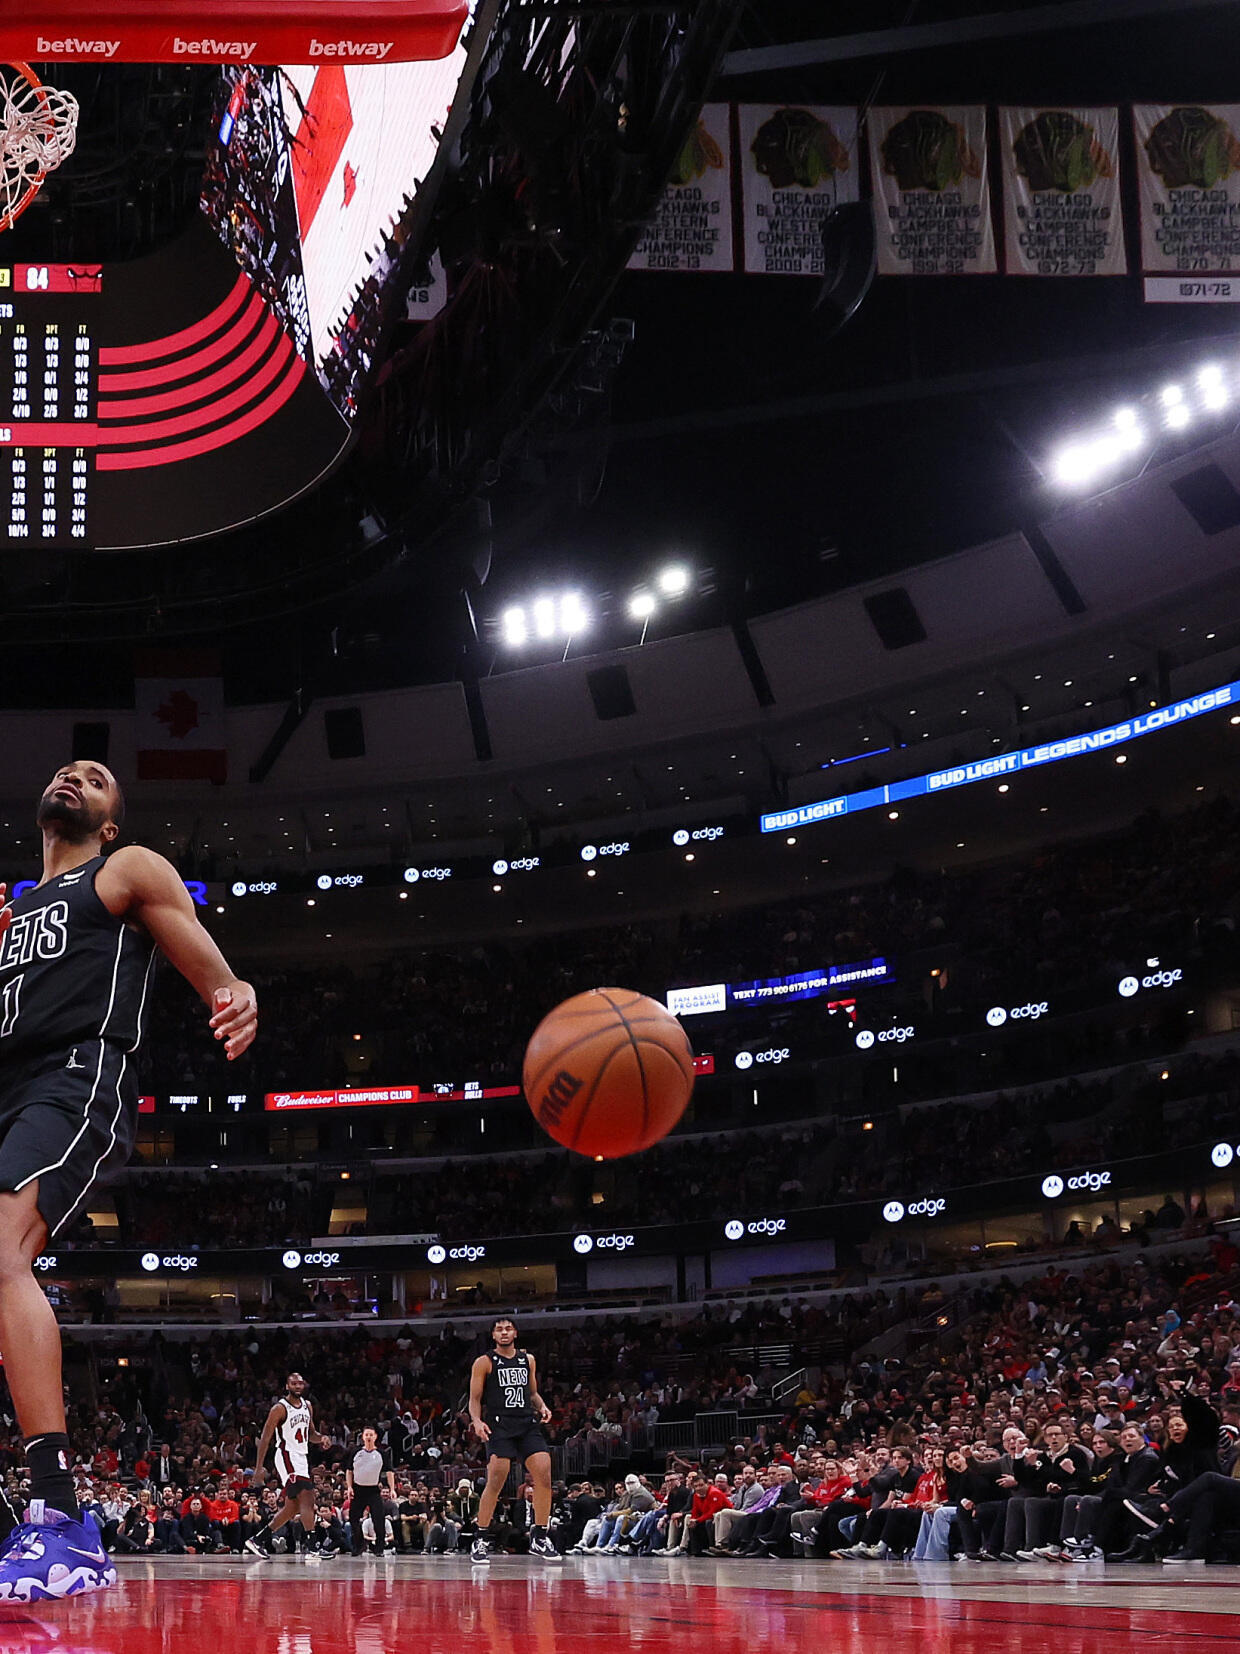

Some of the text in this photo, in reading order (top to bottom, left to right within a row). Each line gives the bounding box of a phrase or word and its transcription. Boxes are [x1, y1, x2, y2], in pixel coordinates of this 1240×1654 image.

[37, 38, 120, 57] betway
[173, 38, 257, 58] betway
[309, 40, 393, 58] betway
[0, 273, 6, 284] 3
[929, 688, 1232, 790] BUD LIGHT LEGENDS LOUNGE
[765, 801, 843, 830] BUD LIGHT
[692, 827, 723, 840] edge
[598, 842, 629, 855] edge
[511, 857, 539, 870] edge
[335, 874, 363, 887] edge
[422, 867, 451, 880] edge
[249, 881, 277, 894] edge
[733, 990, 756, 1000] TEXT
[757, 987, 772, 997] 773
[773, 985, 788, 995] 900
[808, 978, 828, 989] FOR
[829, 965, 887, 984] ASSISTANCE
[1142, 969, 1182, 987] edge
[0, 973, 25, 1038] 1
[673, 1000, 721, 1011] PROGRAM
[1010, 1002, 1048, 1019] edge
[878, 1027, 914, 1042] edge
[756, 1048, 789, 1063] edge
[273, 1089, 413, 1107] Budweiser CHAMPIONS CLUB
[1068, 1171, 1111, 1191] edge
[908, 1198, 945, 1216] edge
[748, 1218, 786, 1235] edge
[597, 1234, 634, 1250] edge
[304, 1251, 339, 1267] edge
[449, 1245, 485, 1261] edge
[163, 1254, 197, 1271] edge
[498, 1367, 528, 1387] NETS
[504, 1386, 525, 1408] 24
